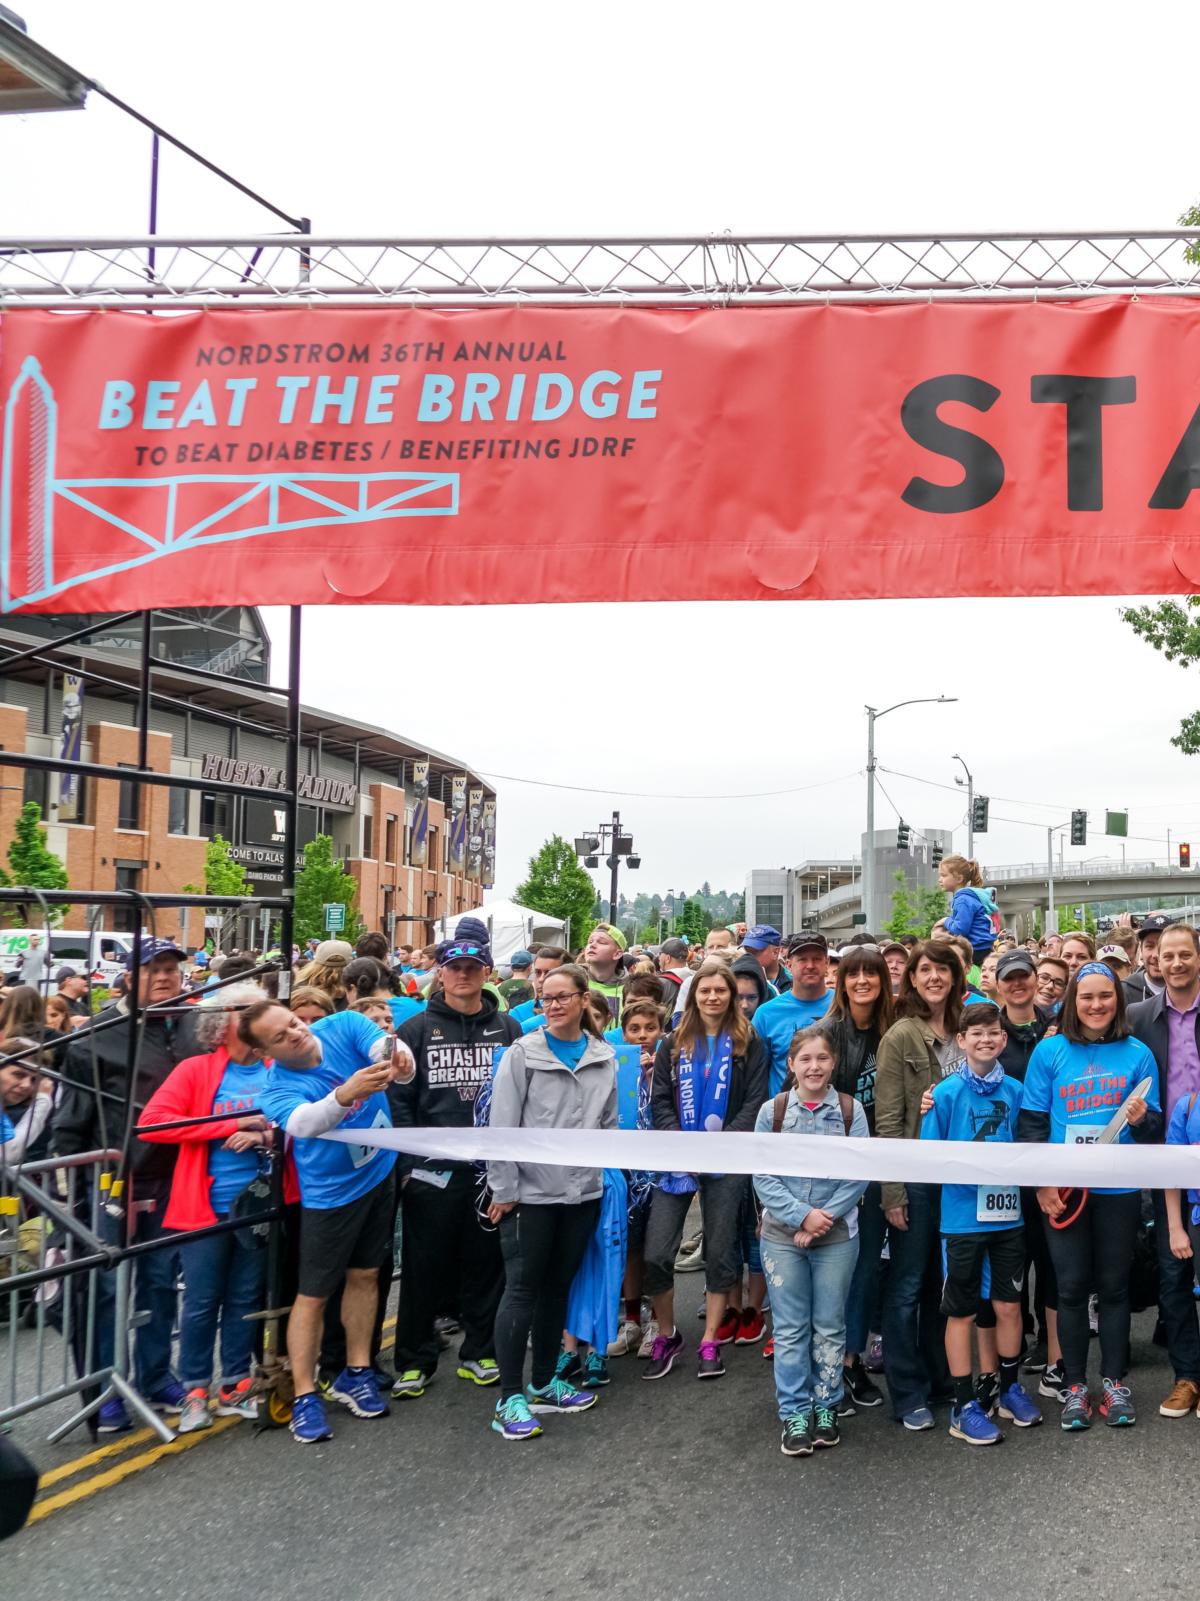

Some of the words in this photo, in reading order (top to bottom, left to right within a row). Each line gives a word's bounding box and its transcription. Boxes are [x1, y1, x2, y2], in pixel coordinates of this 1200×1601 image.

[195, 341, 370, 367] NORDSTROM
[379, 341, 445, 363] 36TH
[455, 340, 567, 363] ANNUAL
[98, 376, 259, 430] BEAT
[276, 374, 401, 426] THE
[416, 369, 663, 423] BRIDGE
[135, 443, 166, 467] TO
[176, 441, 239, 465] BEAT
[247, 439, 375, 463] DIABETES
[380, 438, 392, 461] /
[399, 437, 561, 461] BENEFITING
[568, 437, 636, 460] JDRF
[416, 766, 426, 774] W
[202, 753, 275, 788] HUSKY
[278, 769, 357, 806] ADIUM
[455, 780, 465, 788] W
[252, 851, 263, 861] TO
[1102, 945, 1115, 954] W
[427, 1047, 493, 1069] CHASIN
[428, 1066, 493, 1083] GREATNES
[857, 1071, 877, 1090] EAT
[456, 1086, 478, 1102] W
[1059, 1079, 1094, 1099] BEAT
[1100, 1075, 1127, 1091] THE
[214, 1097, 255, 1115] BEAT
[1066, 1091, 1122, 1113] BRIDGE
[986, 1193, 1018, 1211] 8032
